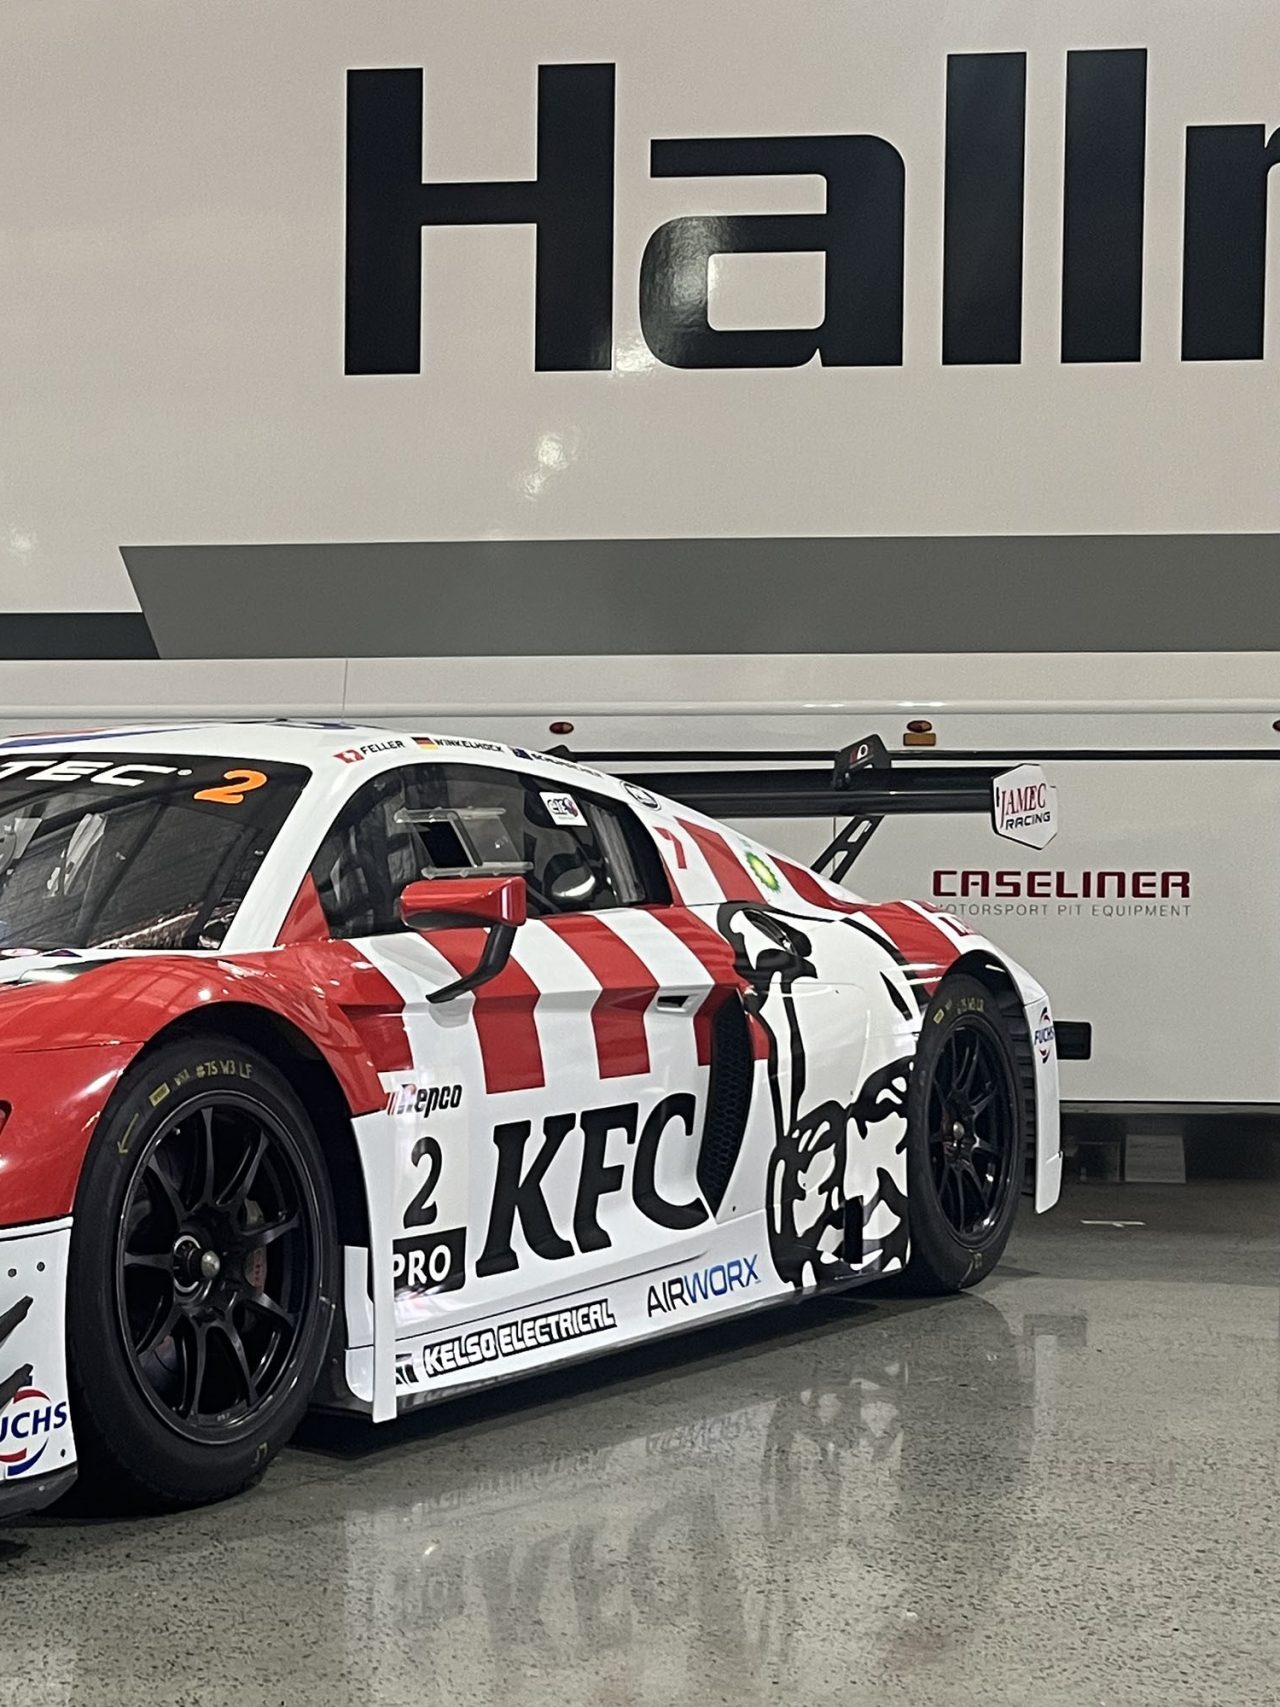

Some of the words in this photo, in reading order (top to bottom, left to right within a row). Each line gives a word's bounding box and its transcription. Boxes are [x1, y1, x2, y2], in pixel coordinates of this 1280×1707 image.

[344, 48, 1280, 375] Hall
[360, 740, 405, 756] FELLER
[194, 769, 268, 804] 2
[999, 783, 1047, 829] JAMEC
[1006, 811, 1051, 830] RACING
[933, 870, 1191, 899] CASELINER
[939, 903, 1048, 917] OTORSPORT
[1057, 904, 1081, 917] PIT
[1092, 904, 1192, 918] EQUIPMENT
[403, 1136, 443, 1229] 2
[475, 1092, 710, 1278] KFC
[648, 1254, 759, 1317] AIRWORX
[424, 1329, 497, 1377] KELSO
[498, 1298, 617, 1357] ELECTRICAL
